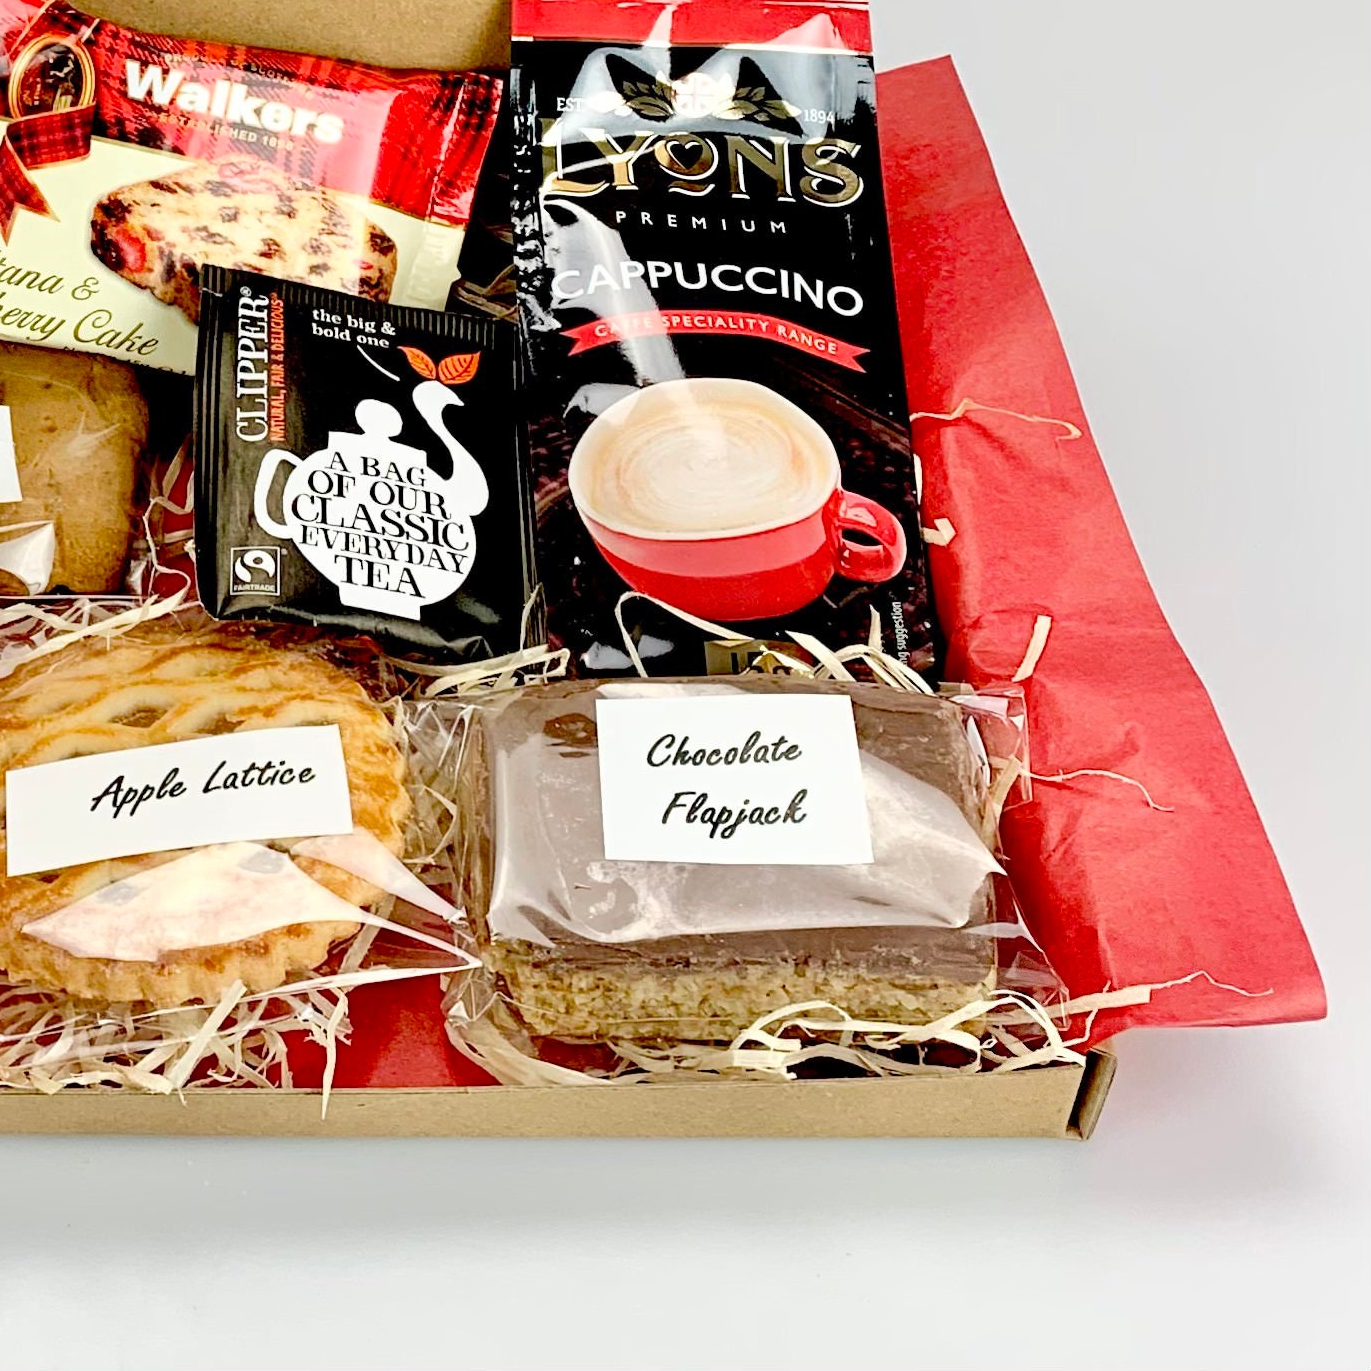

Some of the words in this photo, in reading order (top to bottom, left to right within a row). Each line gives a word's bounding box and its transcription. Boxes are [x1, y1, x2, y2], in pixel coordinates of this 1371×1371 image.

[124, 58, 345, 144] Walkers
[802, 109, 836, 125] 1894
[538, 118, 864, 208] LYONS
[615, 210, 787, 235] PREMIUM
[70, 276, 100, 302] &
[551, 260, 864, 317] CAPPUCCINO
[73, 309, 159, 357] Cake
[270, 299, 285, 352] DELICIOUS
[311, 308, 342, 326] the
[346, 313, 378, 335] big
[380, 320, 397, 337] &
[311, 322, 351, 343] bold
[356, 335, 390, 349] one
[661, 314, 770, 333] SPECIALITY
[777, 324, 839, 355] RANGE
[235, 293, 270, 442] CLIPPER
[271, 363, 285, 387] FAIR
[270, 389, 287, 441] NATURAL,
[325, 451, 349, 473] A
[360, 456, 427, 488] BAG
[307, 469, 356, 500] OF
[369, 480, 452, 522] OUR
[291, 493, 470, 552] CLASSIC
[298, 524, 470, 576] EVERYDAY
[333, 554, 426, 599] TEA
[891, 601, 910, 650] suggestion
[646, 730, 803, 768] Chocolate
[90, 767, 188, 820] Apple
[202, 759, 316, 794] Lattice
[661, 788, 809, 839] Flapjack
